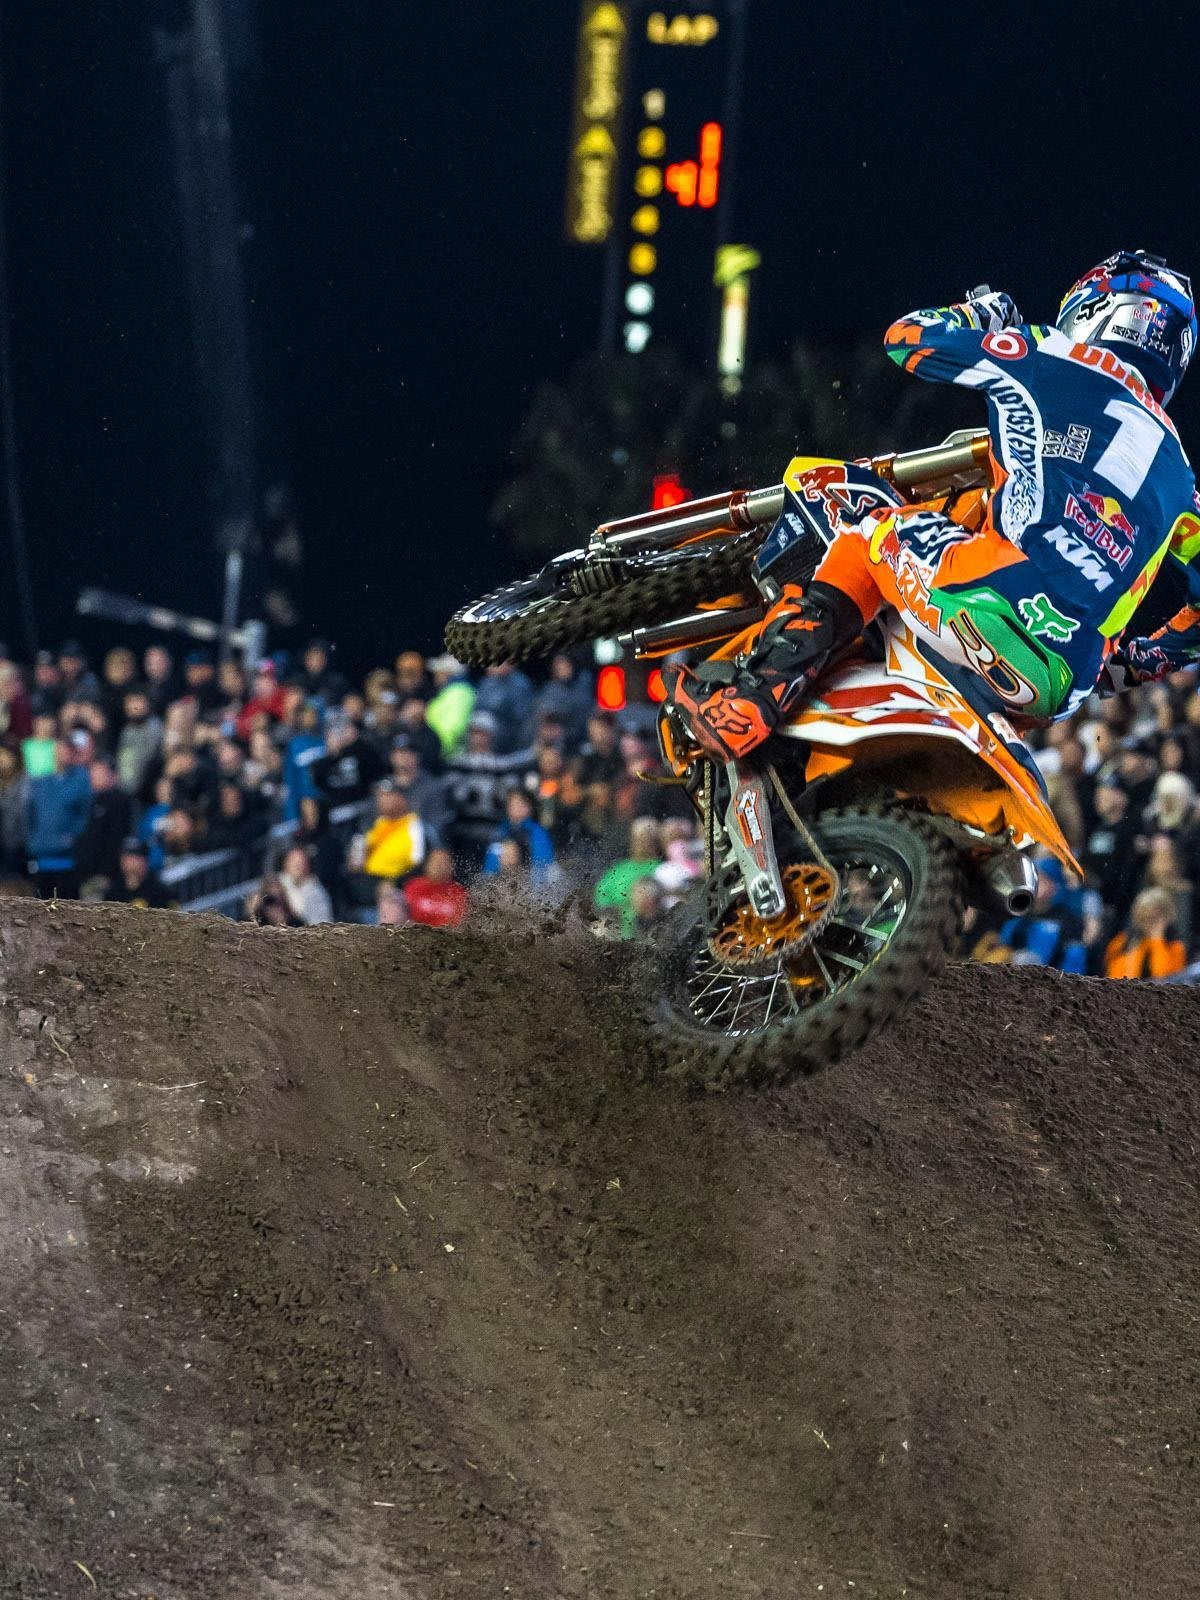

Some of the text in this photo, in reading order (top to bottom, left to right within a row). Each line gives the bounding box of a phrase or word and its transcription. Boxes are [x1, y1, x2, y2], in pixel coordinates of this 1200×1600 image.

[1093, 399, 1165, 500] 1
[1065, 493, 1103, 540] Red
[1043, 525, 1114, 592] KTM
[896, 563, 943, 637] KTM
